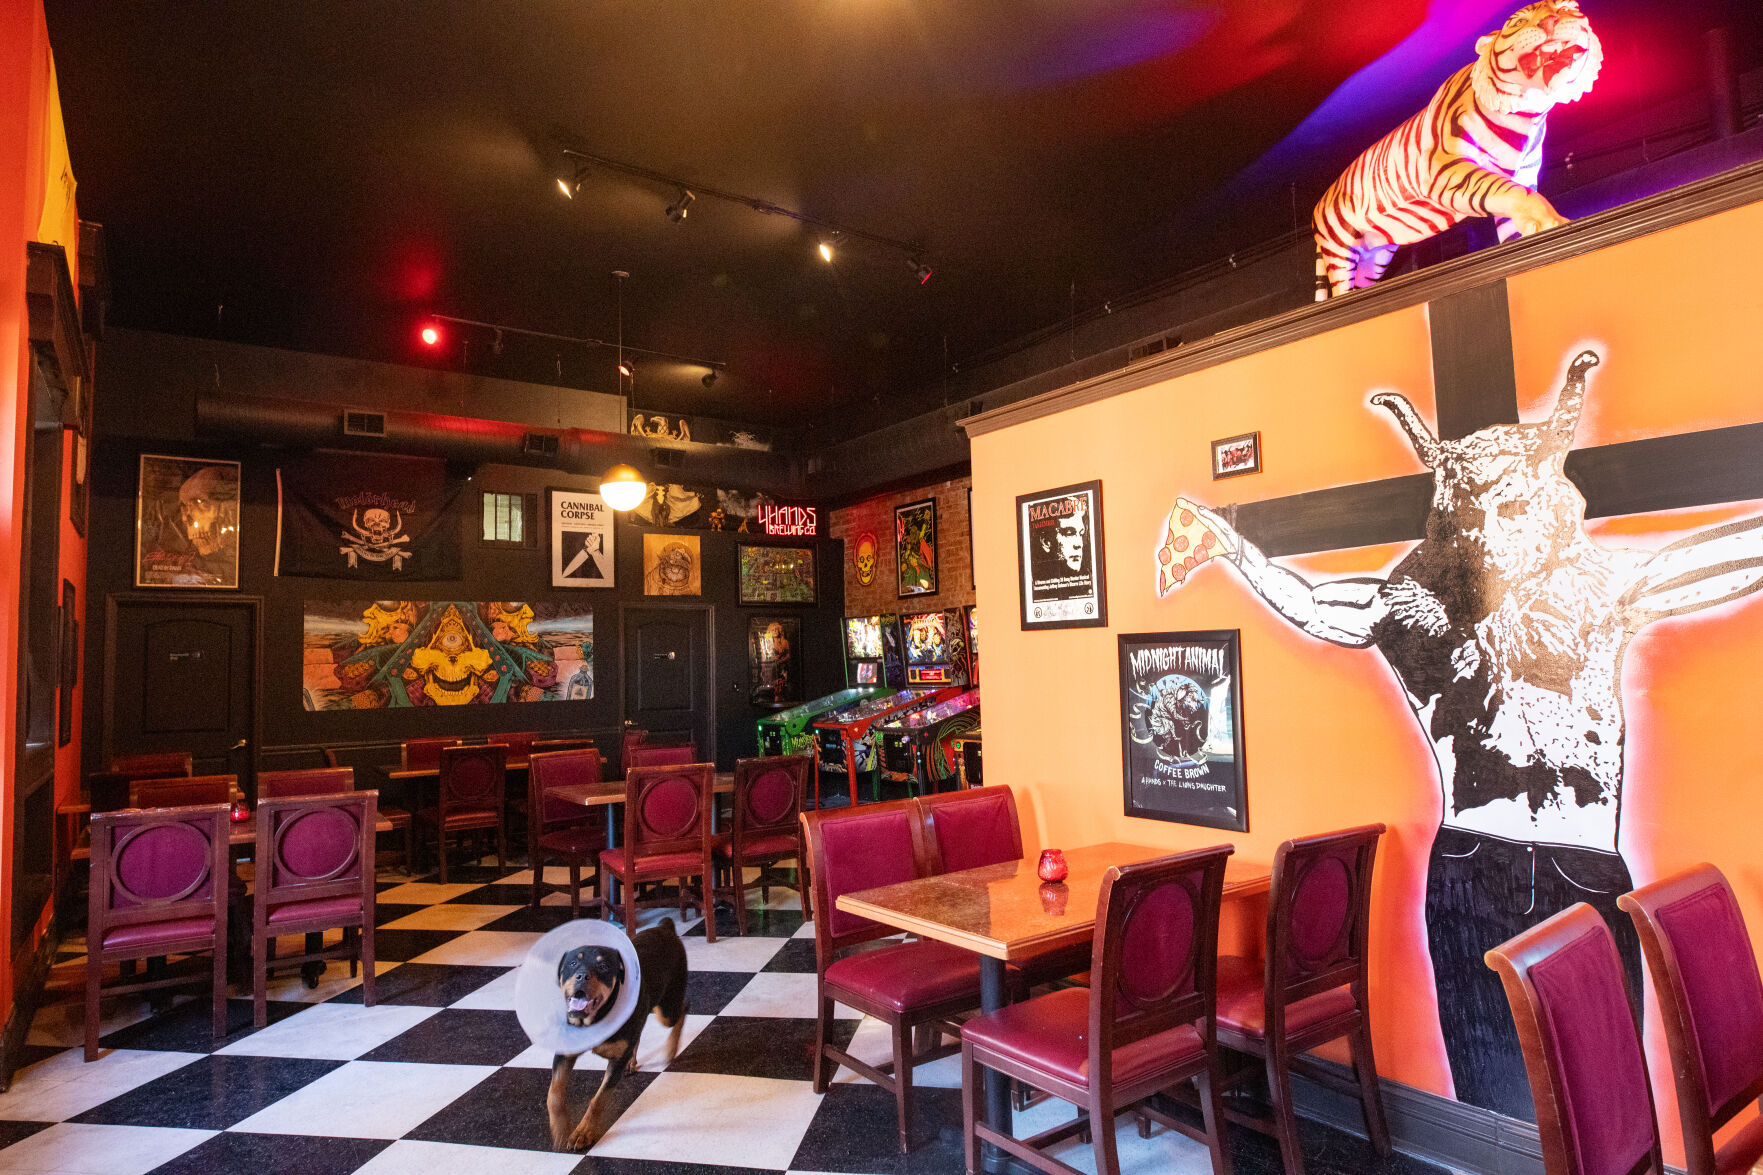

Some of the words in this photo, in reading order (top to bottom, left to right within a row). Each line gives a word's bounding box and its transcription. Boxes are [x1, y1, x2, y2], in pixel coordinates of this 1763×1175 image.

[560, 501, 604, 512] CANNIBAL
[560, 510, 595, 520] CORPSE
[1030, 496, 1087, 521] MACABRE
[1129, 645, 1185, 681] MIDNIGHT
[1184, 646, 1225, 680] ANIMAL
[1154, 759, 1183, 778] COFFEE
[1184, 763, 1210, 779] BROWN
